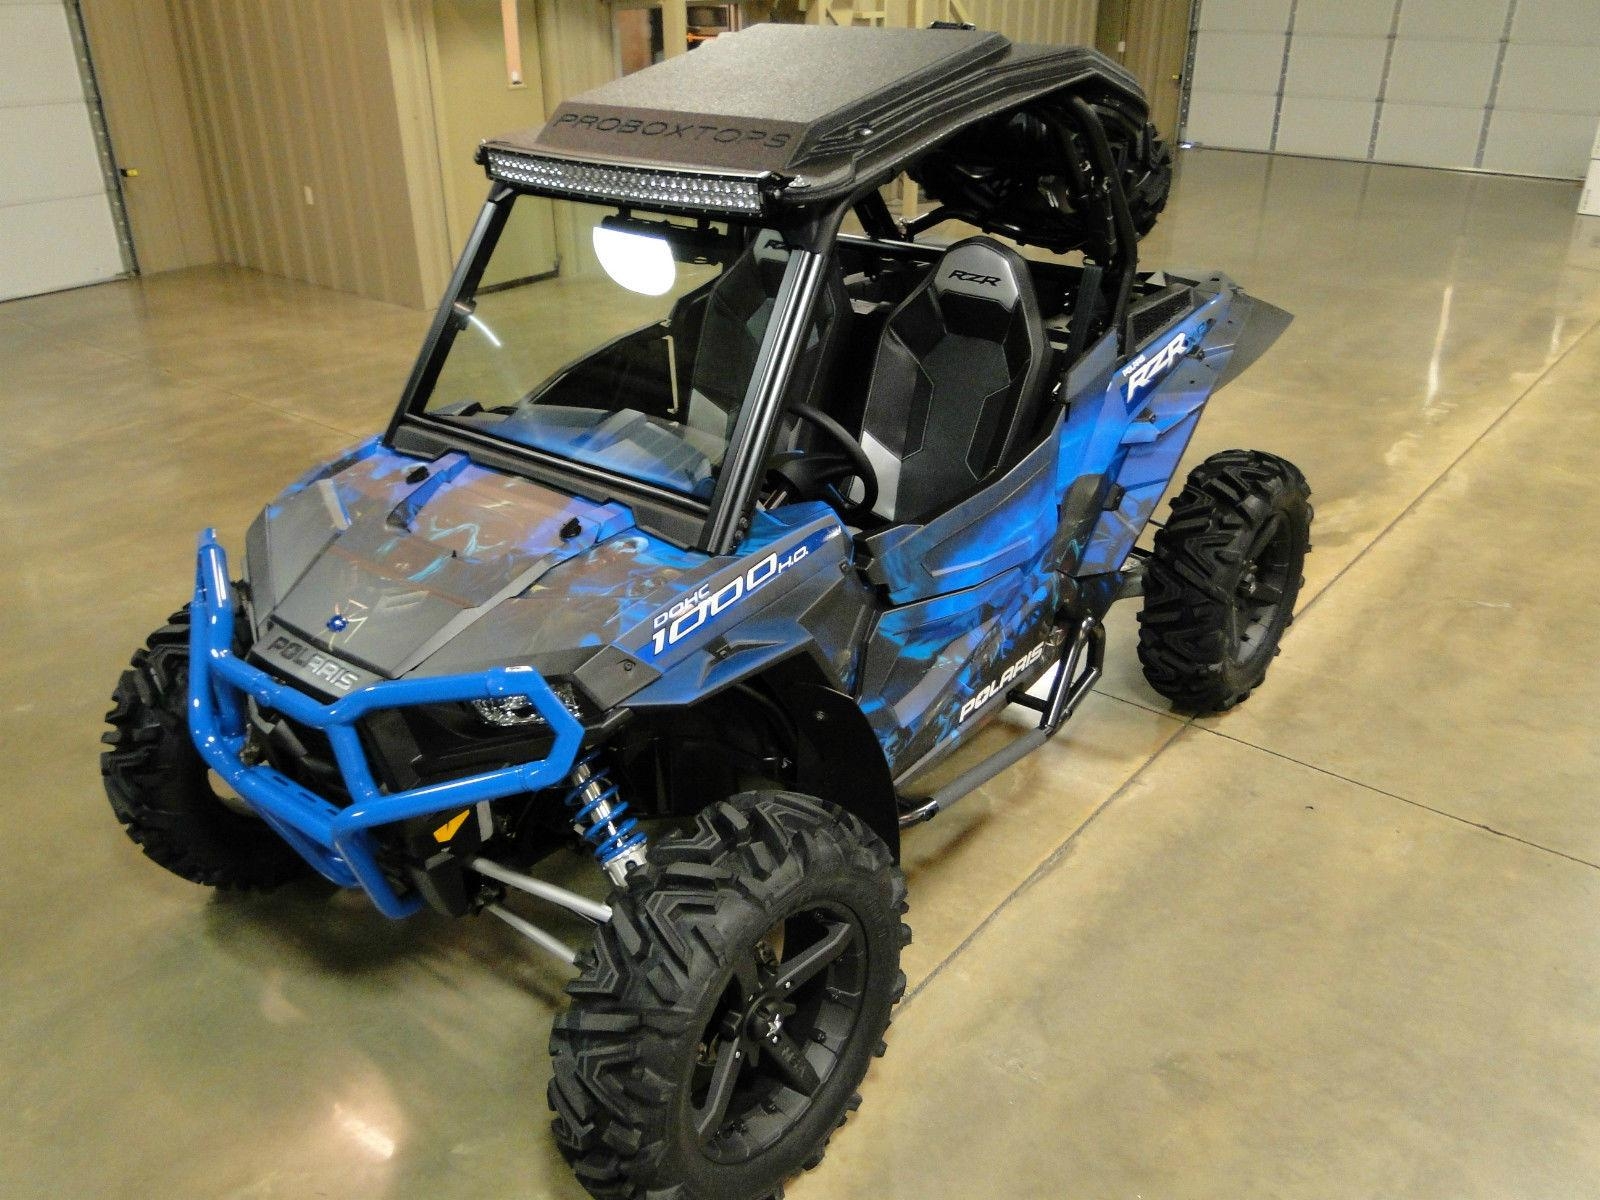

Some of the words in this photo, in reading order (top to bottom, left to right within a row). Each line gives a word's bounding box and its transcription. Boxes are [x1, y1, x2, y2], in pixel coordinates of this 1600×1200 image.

[553, 113, 791, 148] PROBOXTOPS
[948, 269, 1001, 287] RZR
[1126, 332, 1187, 403] RZR
[652, 552, 778, 655] 1000
[653, 583, 710, 630] DOHC
[267, 636, 360, 691] POLARIS
[959, 641, 1045, 723] POLARIS
